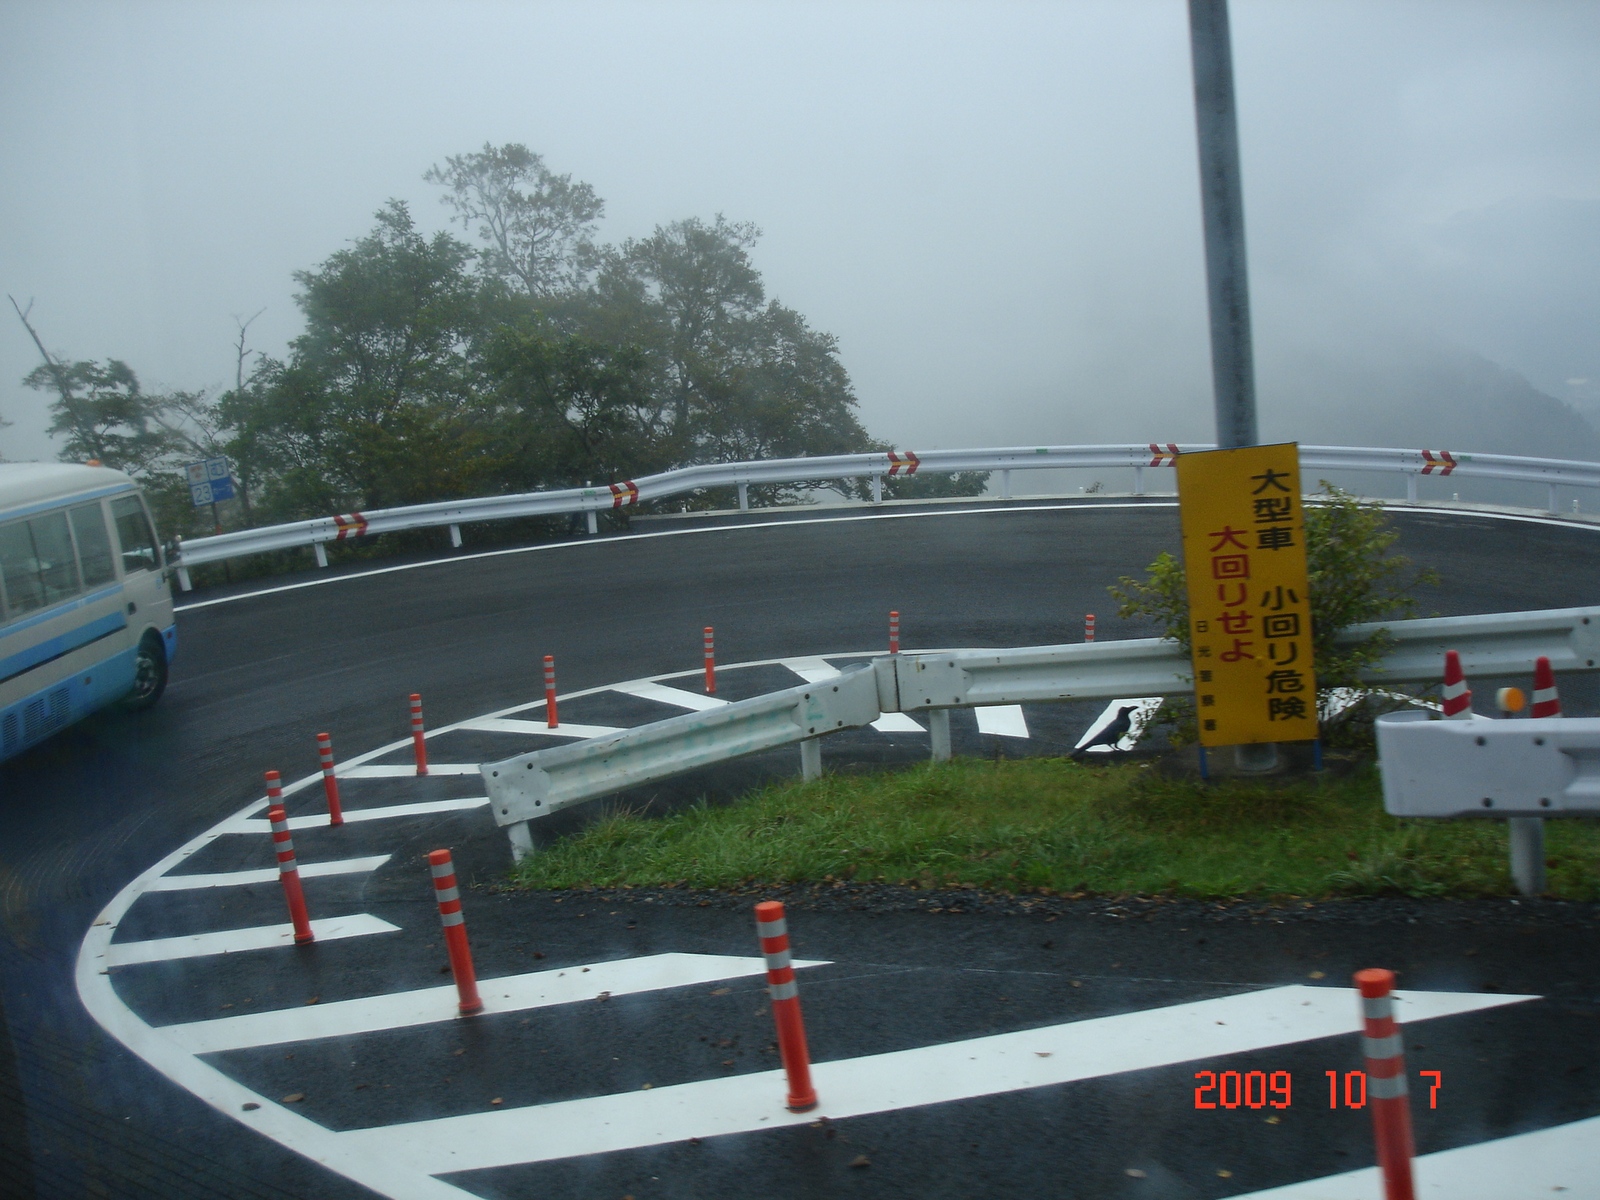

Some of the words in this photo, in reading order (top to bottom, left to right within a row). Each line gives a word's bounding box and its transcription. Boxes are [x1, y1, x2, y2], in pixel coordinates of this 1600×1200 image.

[1251, 468, 1294, 551] 大型車
[1208, 525, 1256, 663] 大回りせよ
[1260, 585, 1307, 722] 小回り危険
